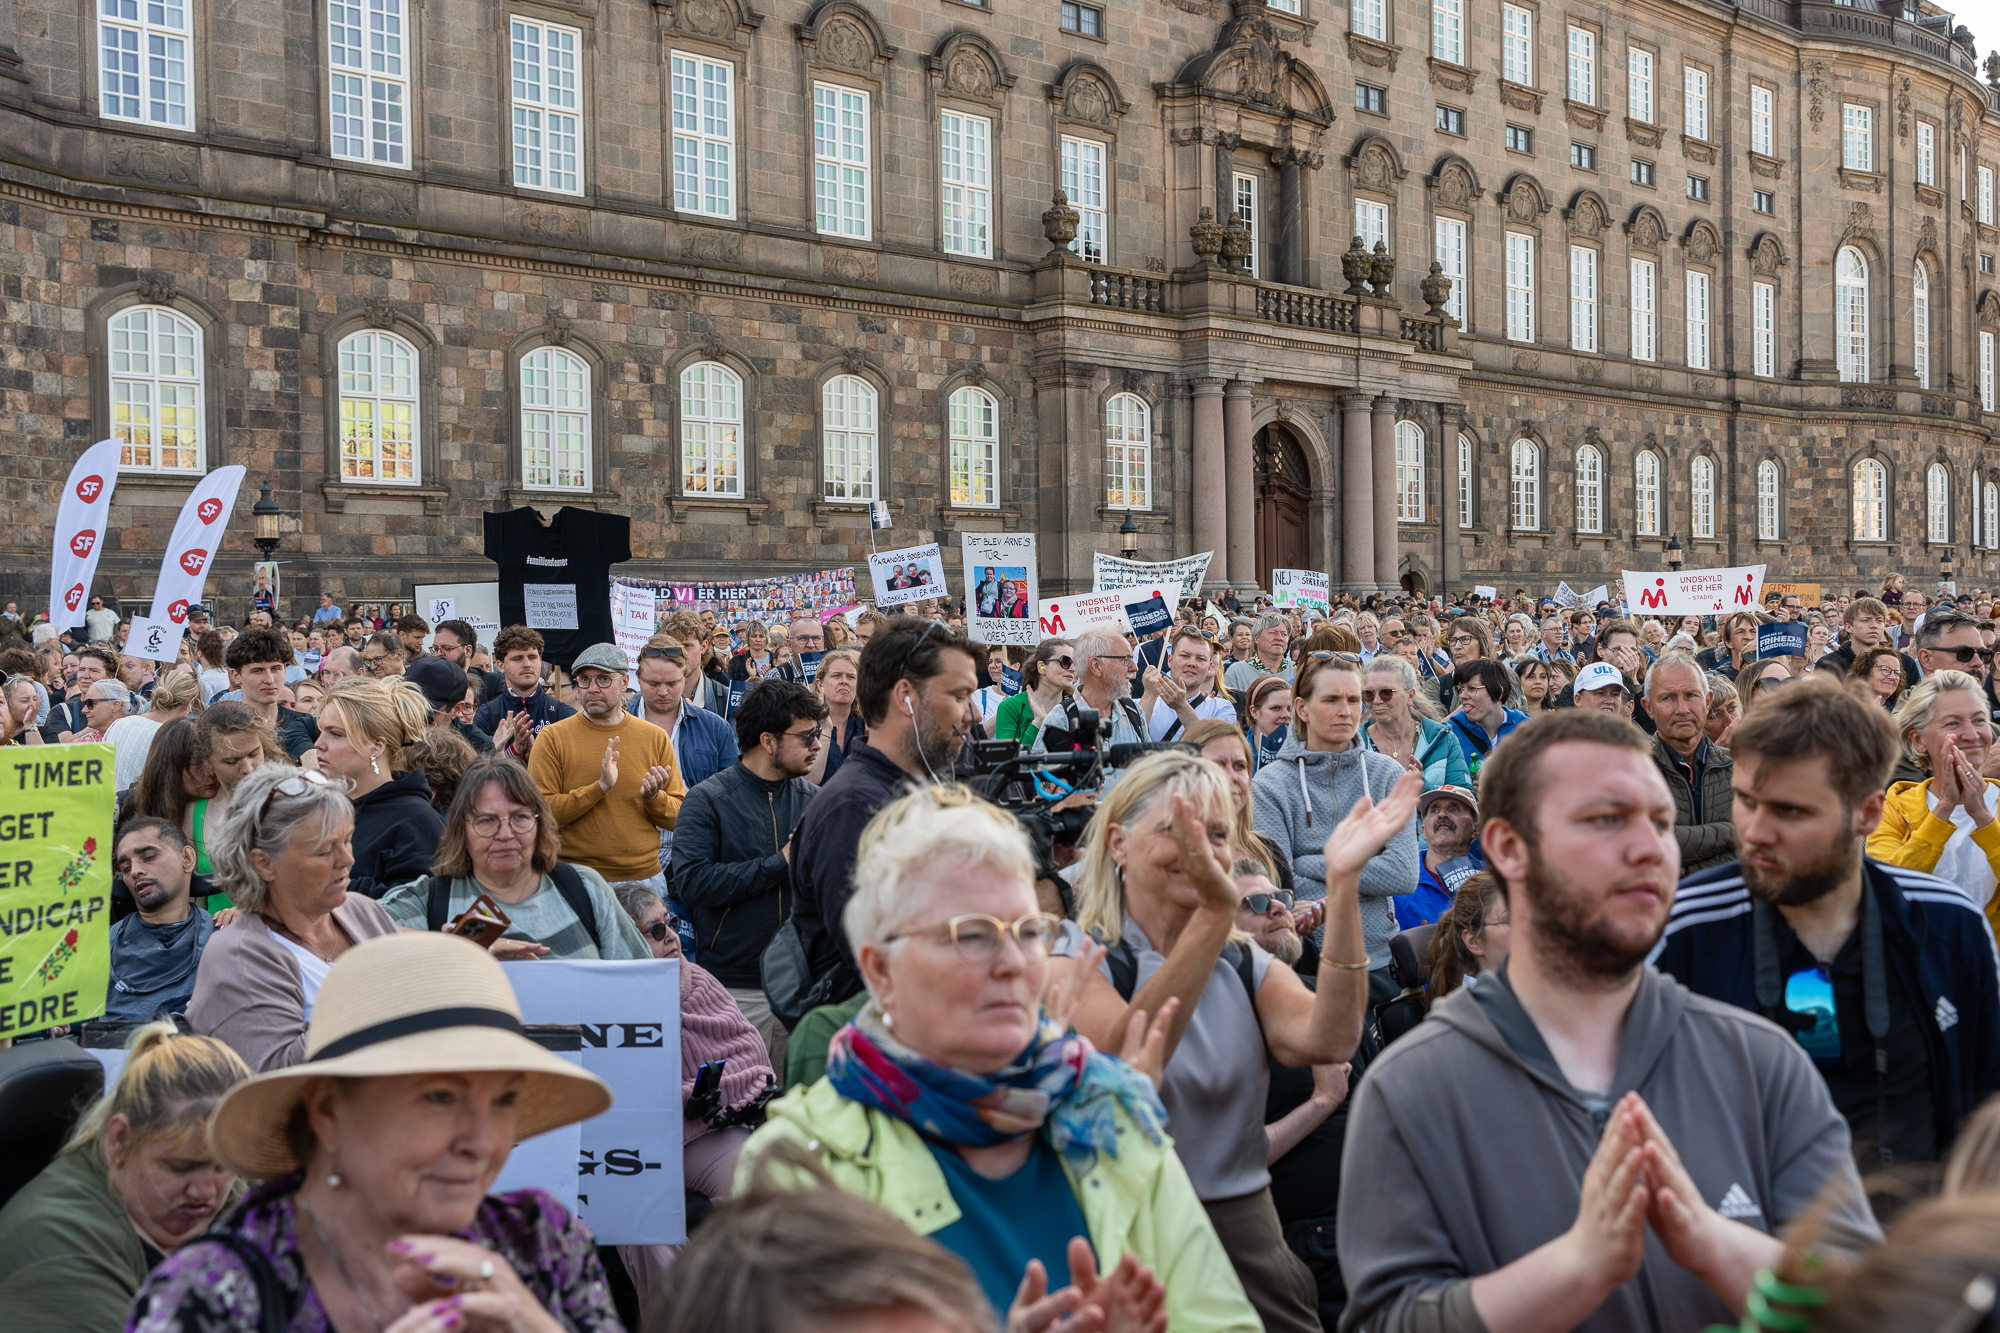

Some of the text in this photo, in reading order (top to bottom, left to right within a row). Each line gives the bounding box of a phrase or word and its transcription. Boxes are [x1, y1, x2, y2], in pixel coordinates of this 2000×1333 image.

[80, 482, 99, 496] SF
[201, 503, 218, 518] SF
[74, 536, 94, 550] SF
[968, 536, 1030, 547] DET BLEV ARNE'S
[184, 554, 204, 568] SF
[1275, 571, 1291, 586] NEJ
[1680, 574, 1722, 583] UNDSKYLD
[68, 590, 81, 604] SF
[674, 588, 693, 601] VI
[698, 588, 715, 599] ER
[720, 588, 748, 599] HER
[920, 588, 928, 597] ER
[1275, 590, 1288, 603] JA
[1076, 595, 1120, 608] UNDSKYLD
[1103, 604, 1122, 612] HER
[172, 604, 187, 619] SF
[630, 610, 648, 620] TAK
[1011, 620, 1020, 630] ER
[1023, 620, 1036, 630] DET
[982, 631, 1032, 643] VORES TUR?
[1760, 642, 1802, 652] VÆRDIGHED
[14, 760, 103, 789] TIMER
